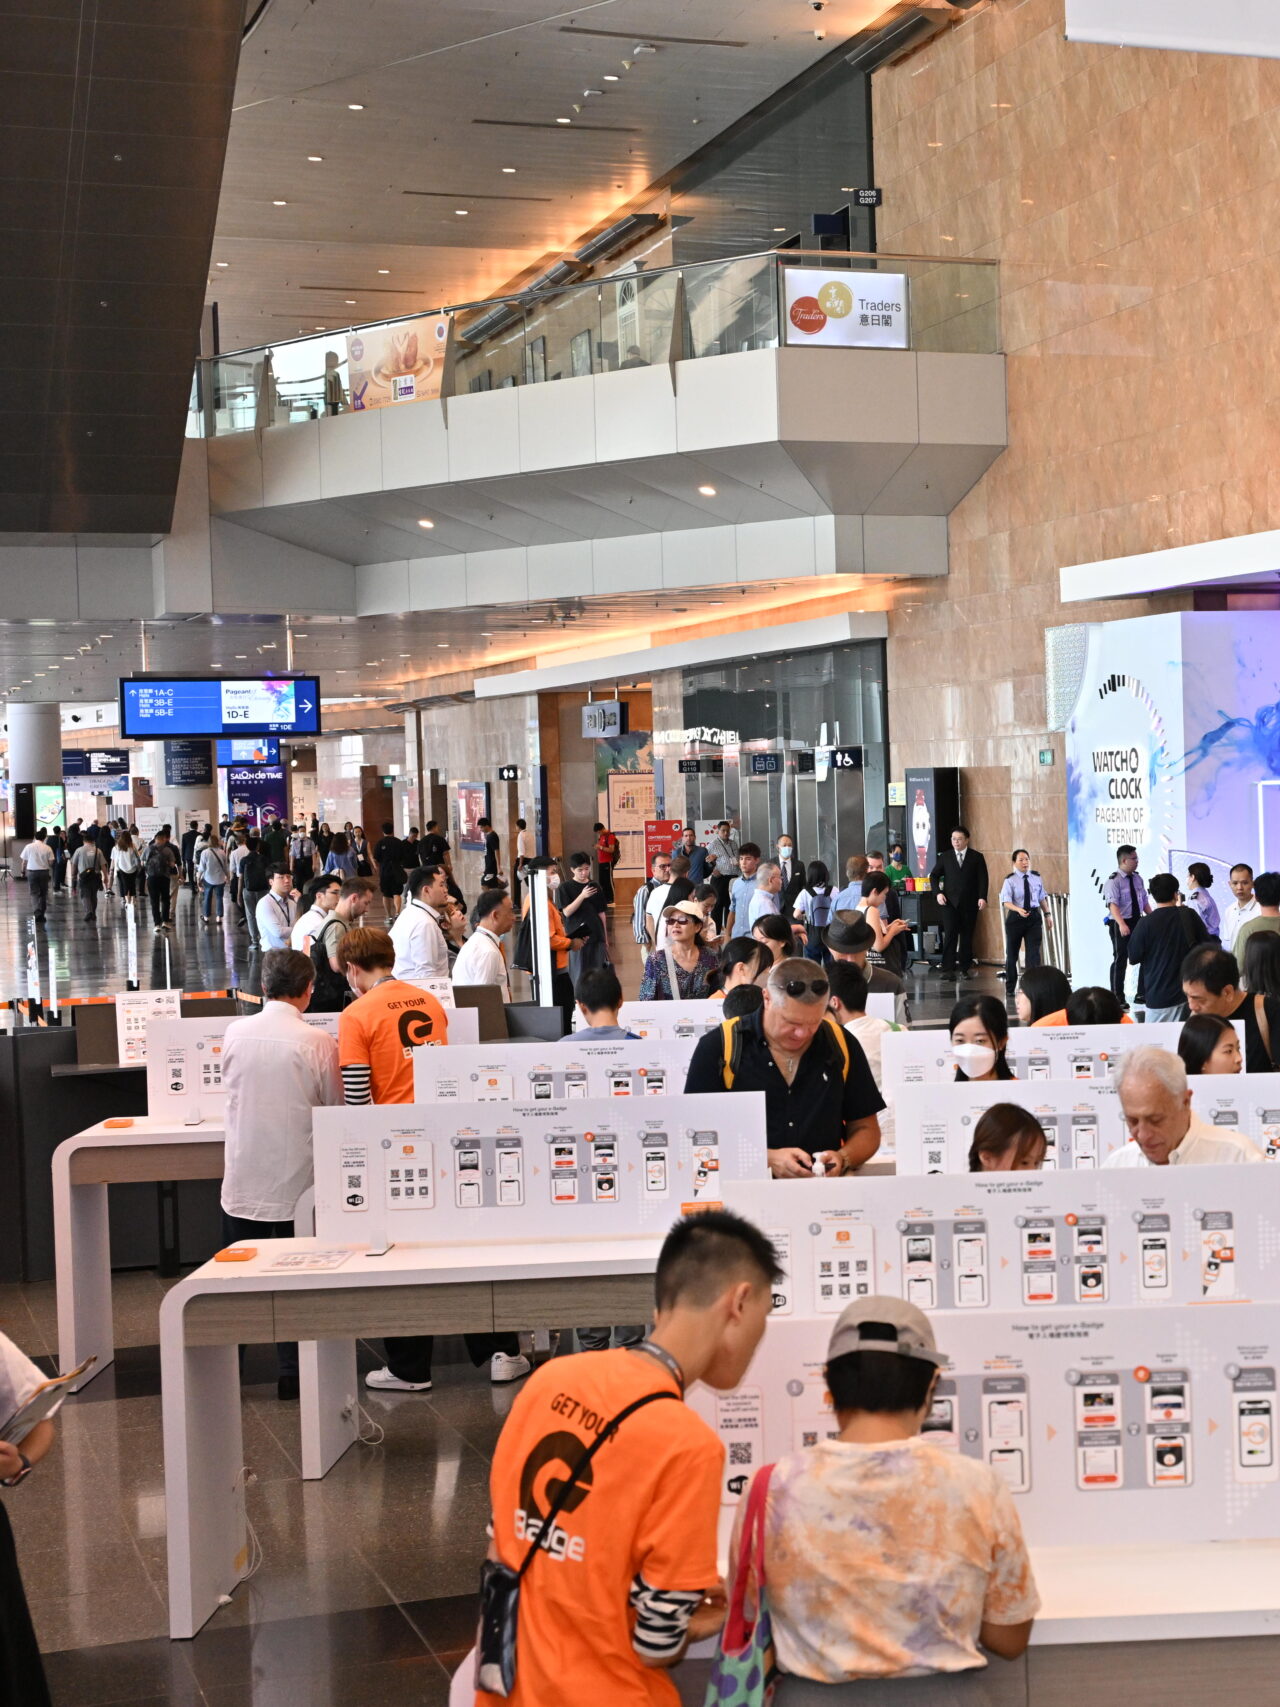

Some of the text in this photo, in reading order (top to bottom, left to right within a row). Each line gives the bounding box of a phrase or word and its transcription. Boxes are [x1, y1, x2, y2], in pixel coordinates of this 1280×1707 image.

[858, 299, 902, 313] Traders
[858, 314, 893, 328] 意日閣
[154, 688, 174, 697] 1A-C
[154, 699, 174, 707] 3B-E
[226, 710, 250, 719] 1D-E
[1092, 750, 1129, 773] WATCH
[230, 771, 254, 780] SALON
[255, 770, 266, 780] de
[1108, 777, 1143, 800] CLOCK
[1095, 807, 1144, 823] PAGEANT OF
[1107, 828, 1144, 844] ETERNITY
[387, 998, 426, 1010] GET YOUR
[1040, 1324, 1052, 1332] get
[551, 1393, 580, 1420] GET
